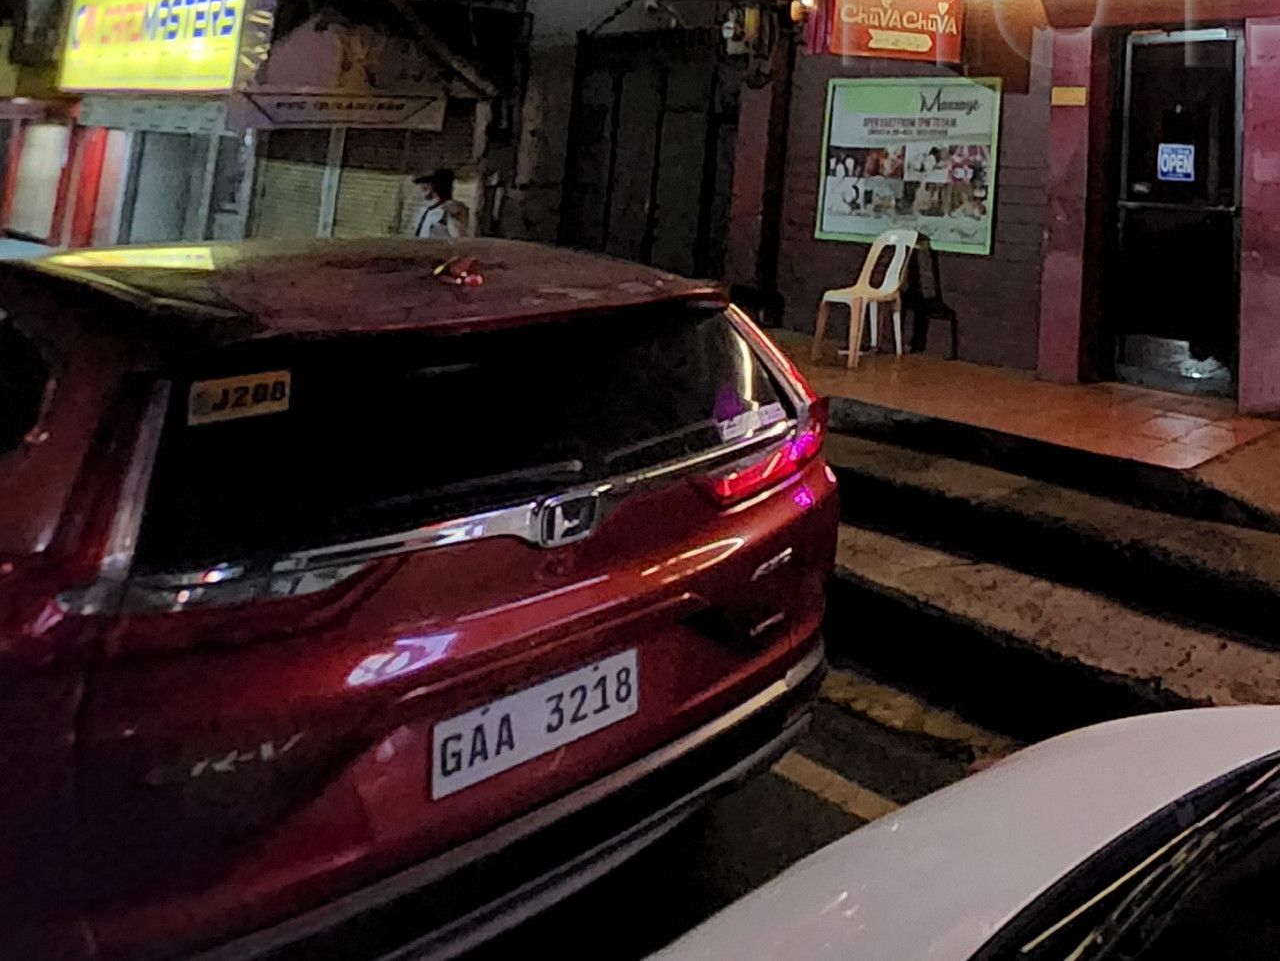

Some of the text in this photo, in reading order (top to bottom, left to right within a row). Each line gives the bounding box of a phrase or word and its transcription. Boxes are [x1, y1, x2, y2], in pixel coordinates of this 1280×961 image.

[1162, 153, 1191, 173] OPEN
[440, 666, 632, 778] GAA 3218
